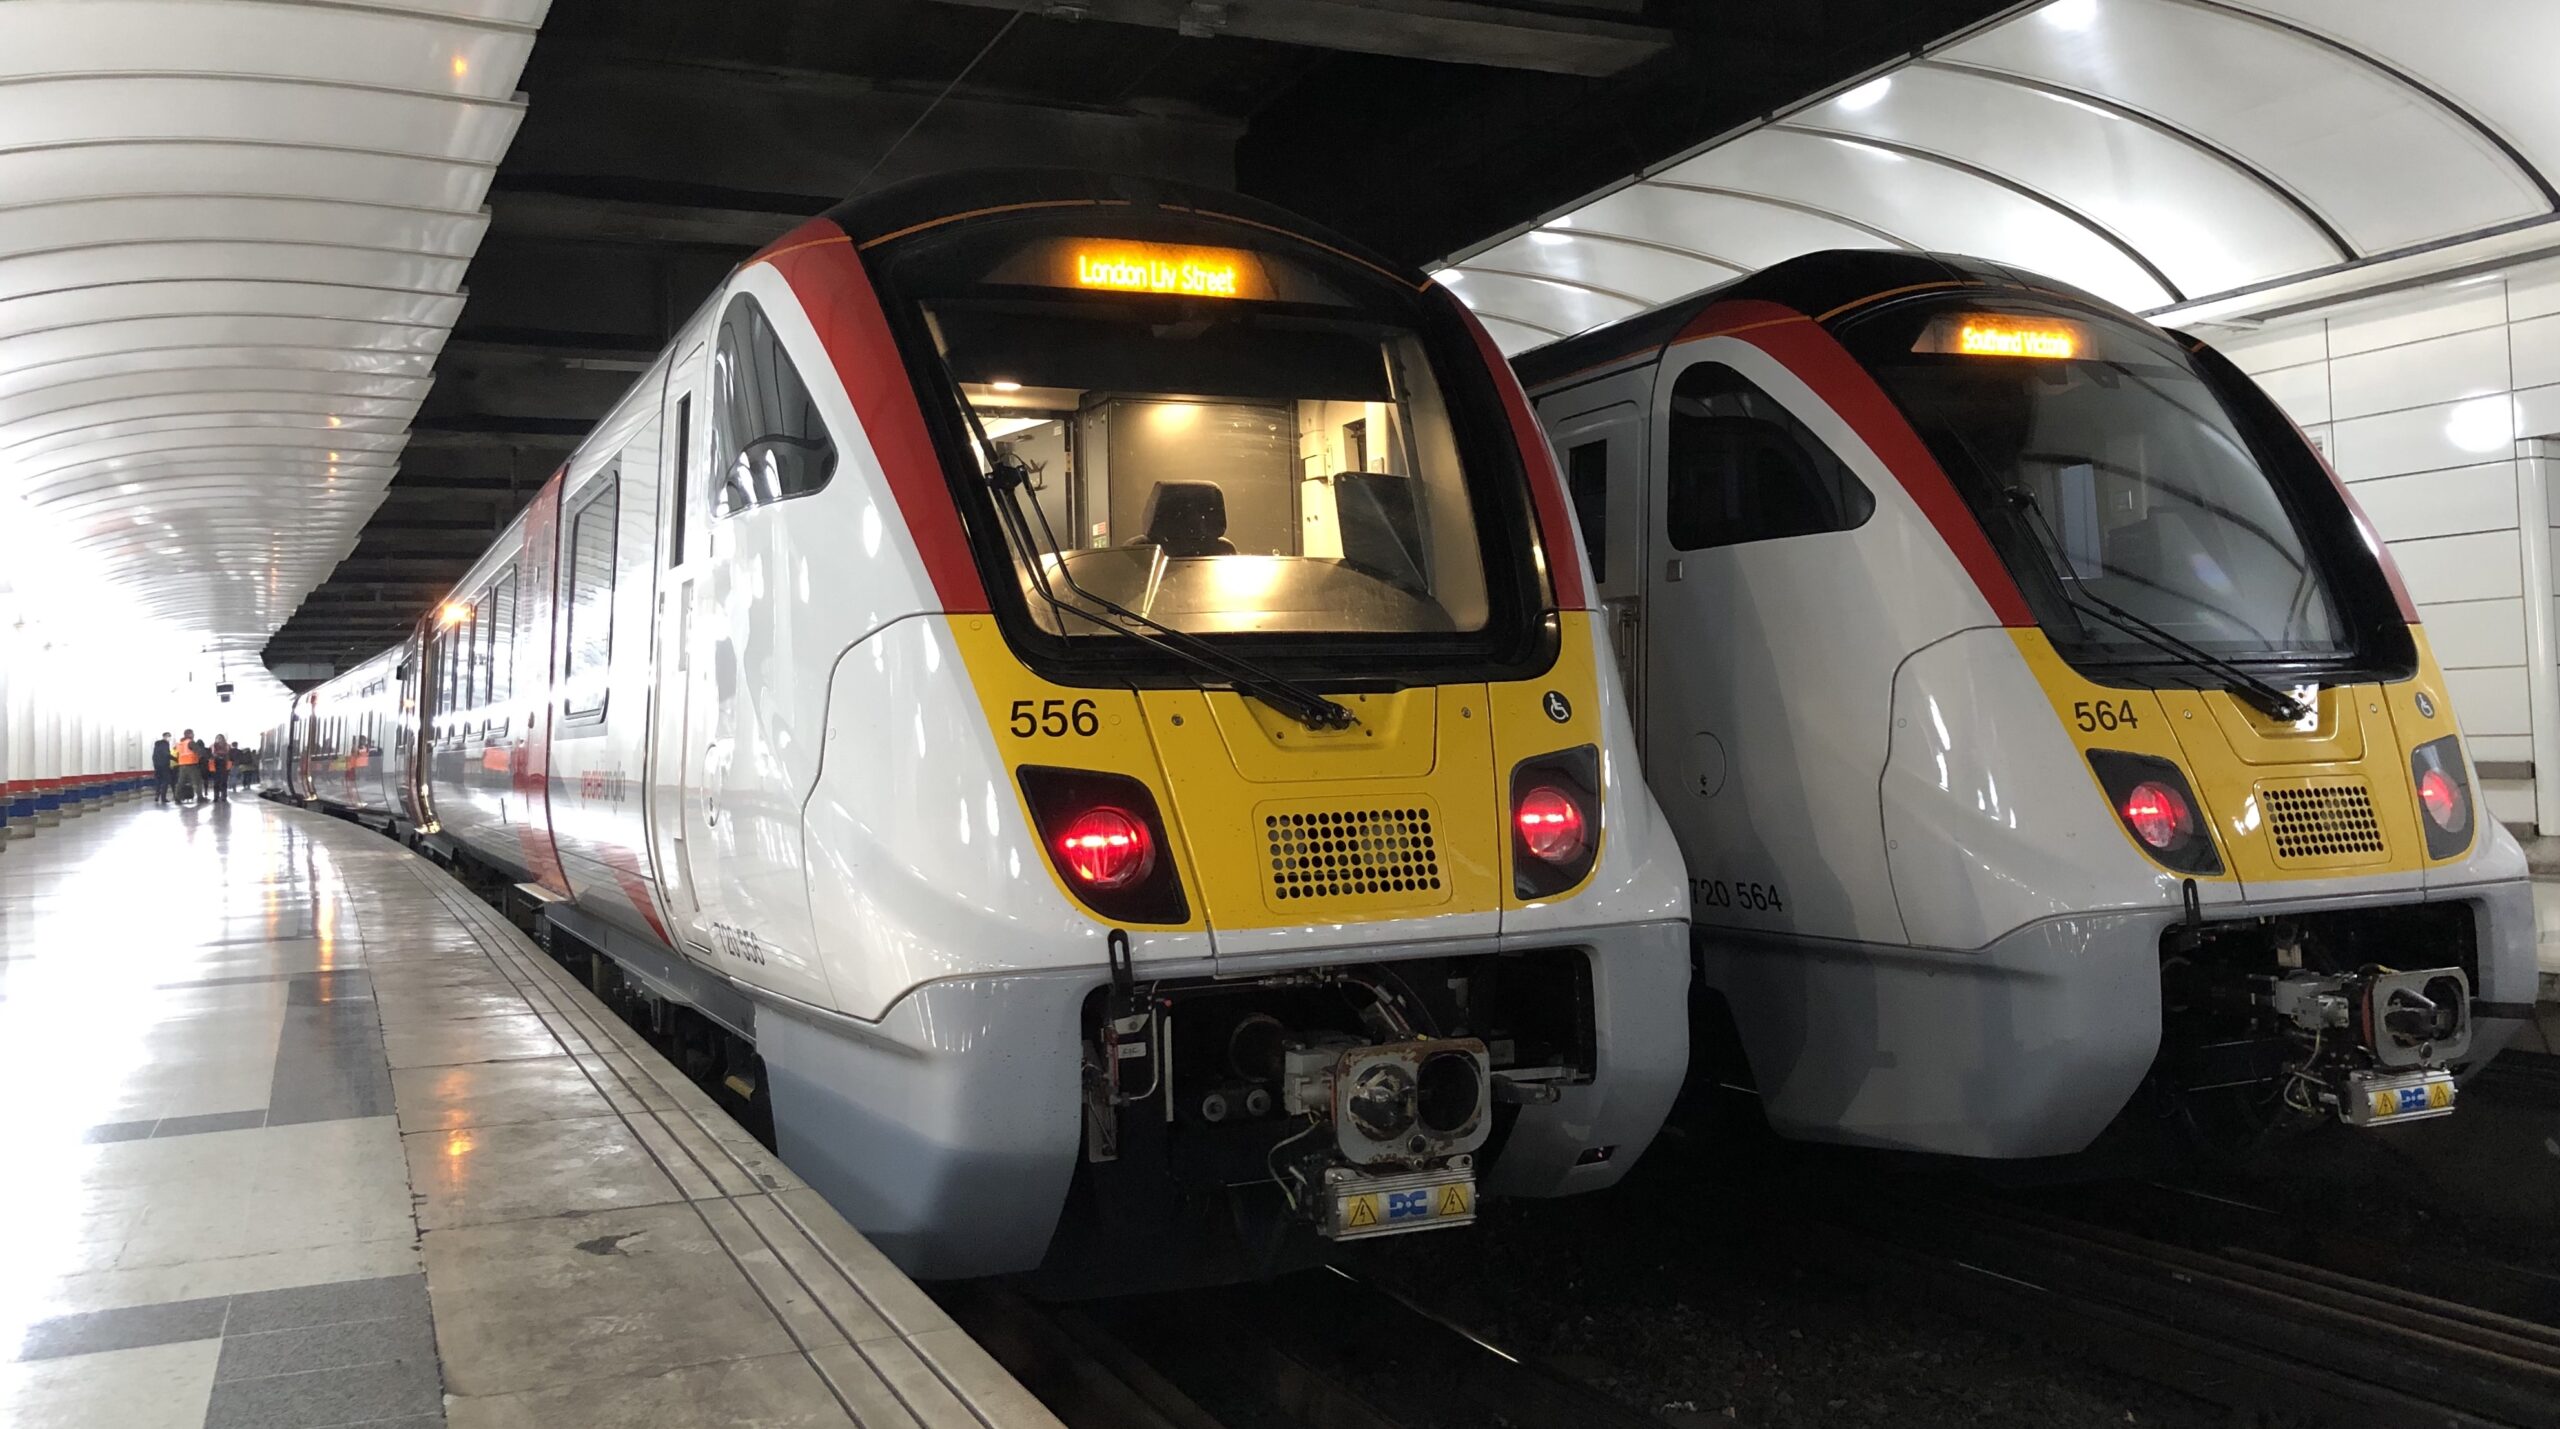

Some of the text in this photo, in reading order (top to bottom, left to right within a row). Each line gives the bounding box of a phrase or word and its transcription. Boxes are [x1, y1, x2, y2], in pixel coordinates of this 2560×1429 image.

[1079, 255, 1236, 294] London Liv Street
[1010, 698, 1099, 738] 556
[2074, 699, 2138, 732] 564
[1689, 878, 1783, 912] 720 564
[713, 921, 766, 966] 720 556
